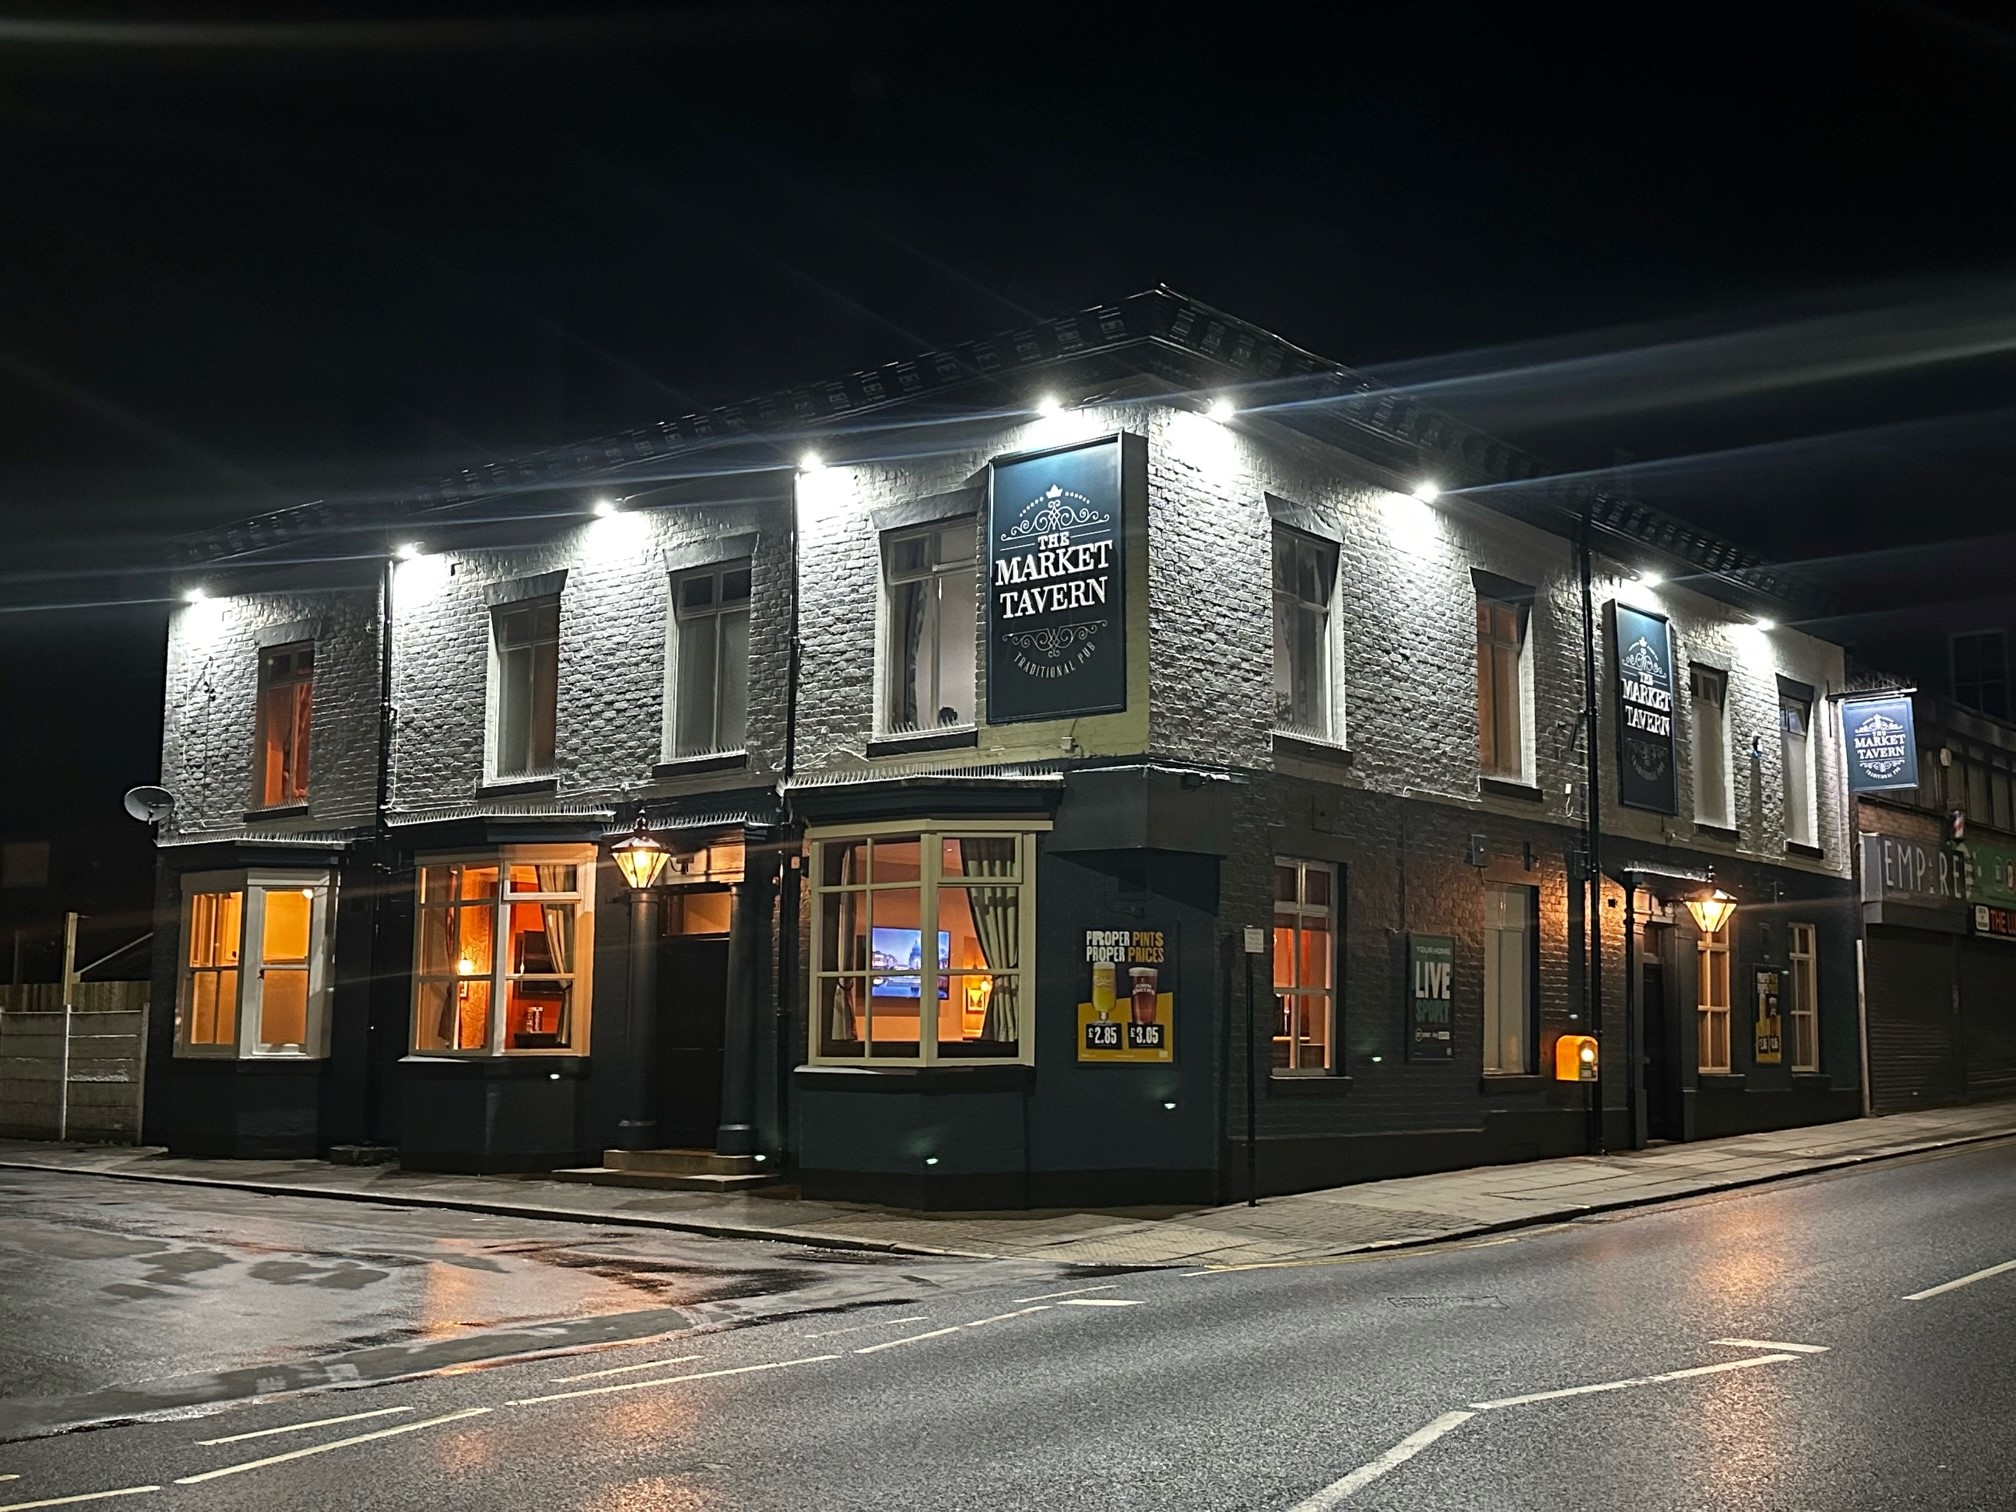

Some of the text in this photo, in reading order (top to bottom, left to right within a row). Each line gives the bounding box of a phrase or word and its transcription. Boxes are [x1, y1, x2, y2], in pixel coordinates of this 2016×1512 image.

[1038, 530, 1070, 549] THE
[995, 539, 1113, 587] MARKET
[1000, 576, 1108, 619] TAVERN
[1013, 641, 1096, 678] TRADITIONAL PUB
[1638, 671, 1654, 686] THE
[1621, 678, 1671, 712] MARKET
[1625, 705, 1671, 737] TAVERN
[1854, 733, 1906, 748] MARKET
[1857, 746, 1905, 759] TAVERN
[1884, 840, 1962, 899] EMPRE
[1086, 930, 1164, 947] PROPER PINTS
[1086, 946, 1164, 963] PROPER PRICES
[1415, 960, 1450, 999] LIVE
[1415, 999, 1450, 1023] SPORT
[1088, 1026, 1117, 1044] £2.85
[1130, 1026, 1159, 1044] £3.05
